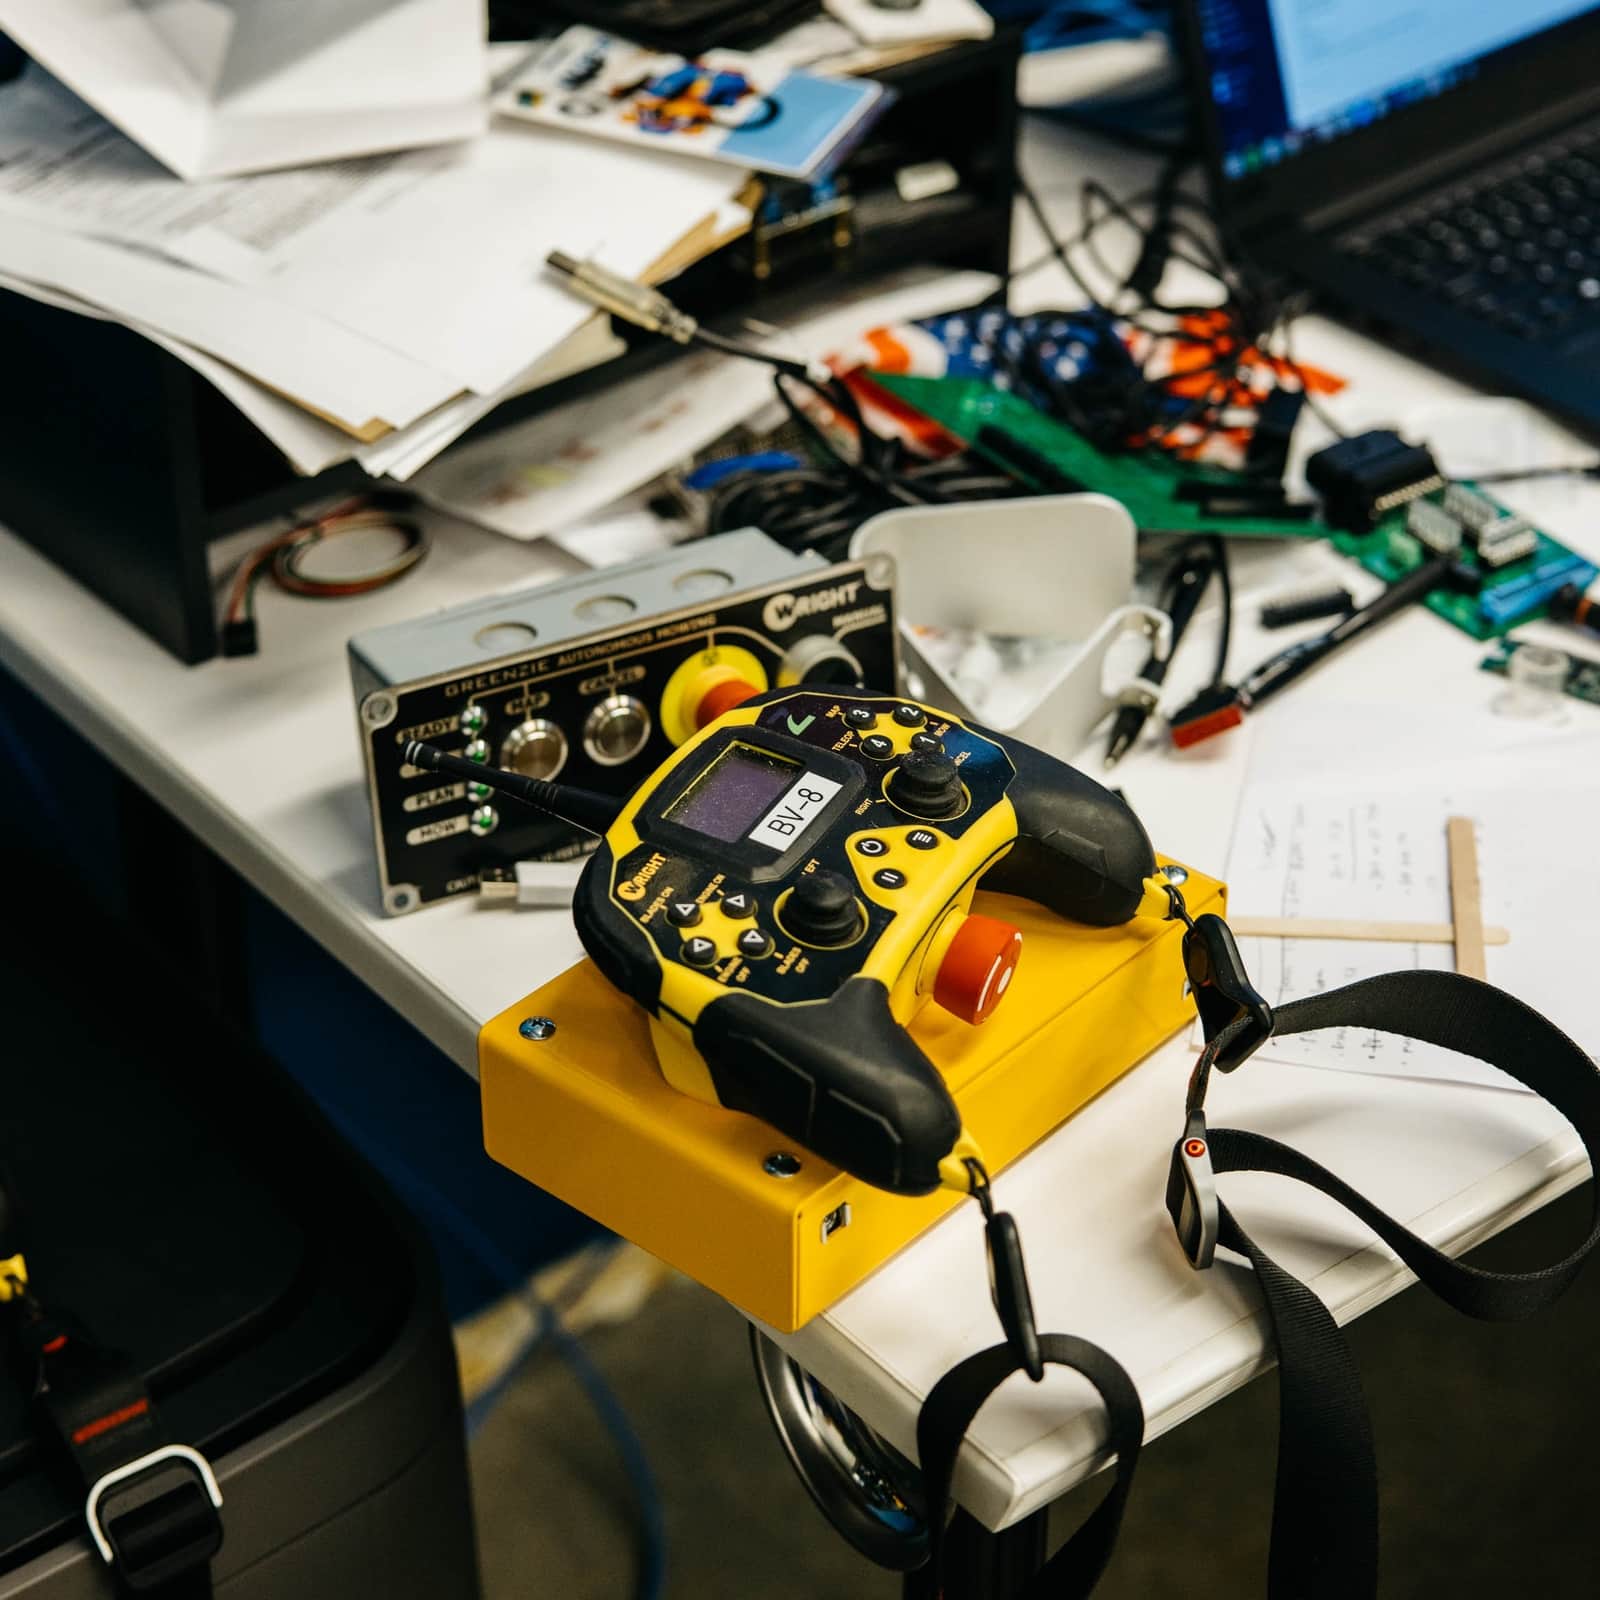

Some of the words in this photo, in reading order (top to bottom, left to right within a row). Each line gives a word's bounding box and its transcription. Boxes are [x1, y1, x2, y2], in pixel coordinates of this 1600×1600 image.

[763, 582, 862, 632] WRIGHT
[445, 658, 549, 697] GREENZIE
[558, 632, 652, 667] AUTONOMOUS
[656, 614, 717, 640] MOWING
[825, 705, 841, 719] MAP
[852, 709, 870, 719] 3
[902, 706, 919, 717] 2
[934, 722, 951, 738] MOW
[832, 730, 855, 752] TELEOP
[869, 738, 888, 749] 4
[919, 736, 936, 745] 1
[415, 787, 454, 806] PLAN
[767, 788, 824, 836] BV-8
[855, 798, 873, 816] RIGHT
[420, 823, 456, 838] MOW
[801, 858, 820, 876] EFT
[616, 852, 667, 902] WRIGHT
[695, 882, 718, 903] ENGINE
[713, 873, 726, 885] ON
[640, 896, 665, 923] BLADES
[661, 886, 674, 898] ON
[775, 946, 802, 975] BLADES
[795, 957, 809, 974] OFF
